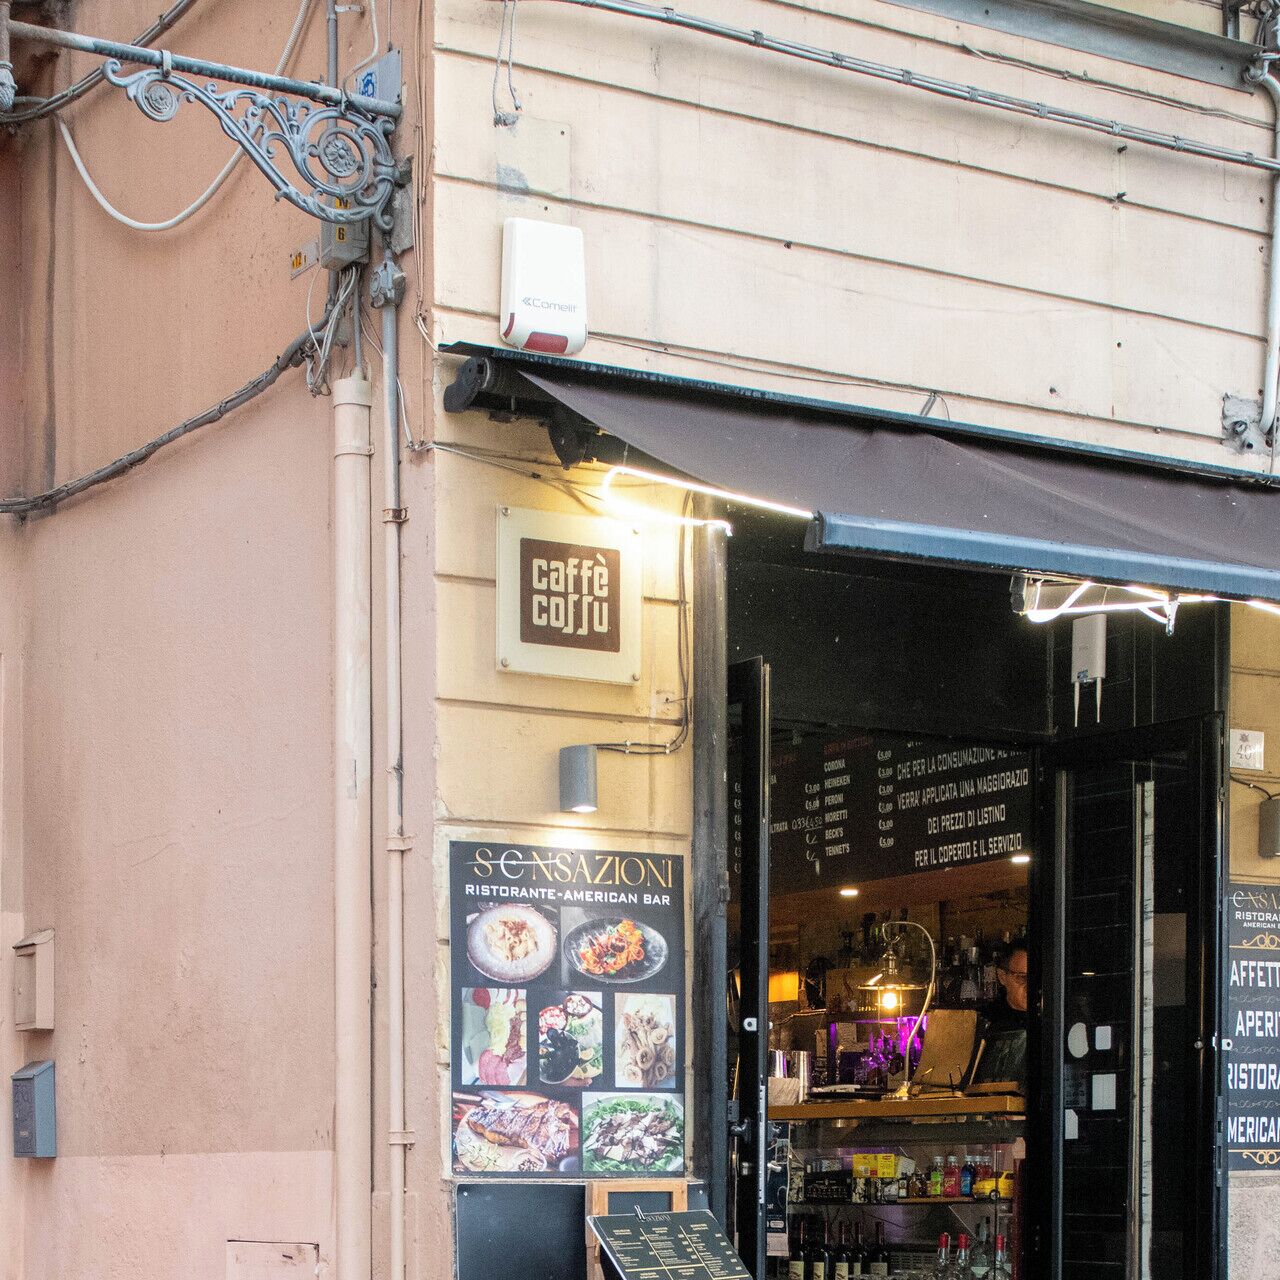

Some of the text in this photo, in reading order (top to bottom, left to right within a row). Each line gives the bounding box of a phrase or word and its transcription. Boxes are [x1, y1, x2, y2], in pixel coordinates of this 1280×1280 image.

[531, 297, 577, 313] Comelit
[532, 553, 609, 598] caffè
[912, 758, 926, 776] PER
[927, 756, 936, 773] LA
[922, 781, 958, 805] APPLICATA
[960, 778, 976, 798] UNA
[977, 767, 1029, 794] MAGGIORAZIO
[927, 803, 1006, 834] DEI PREZZI DI LISTINO
[915, 832, 1022, 867] PER IL COPERTO E IL SERVIZIO
[473, 848, 673, 889] SENSAZIONI
[643, 893, 671, 906] BAR
[1243, 921, 1276, 929] AMERICAN
